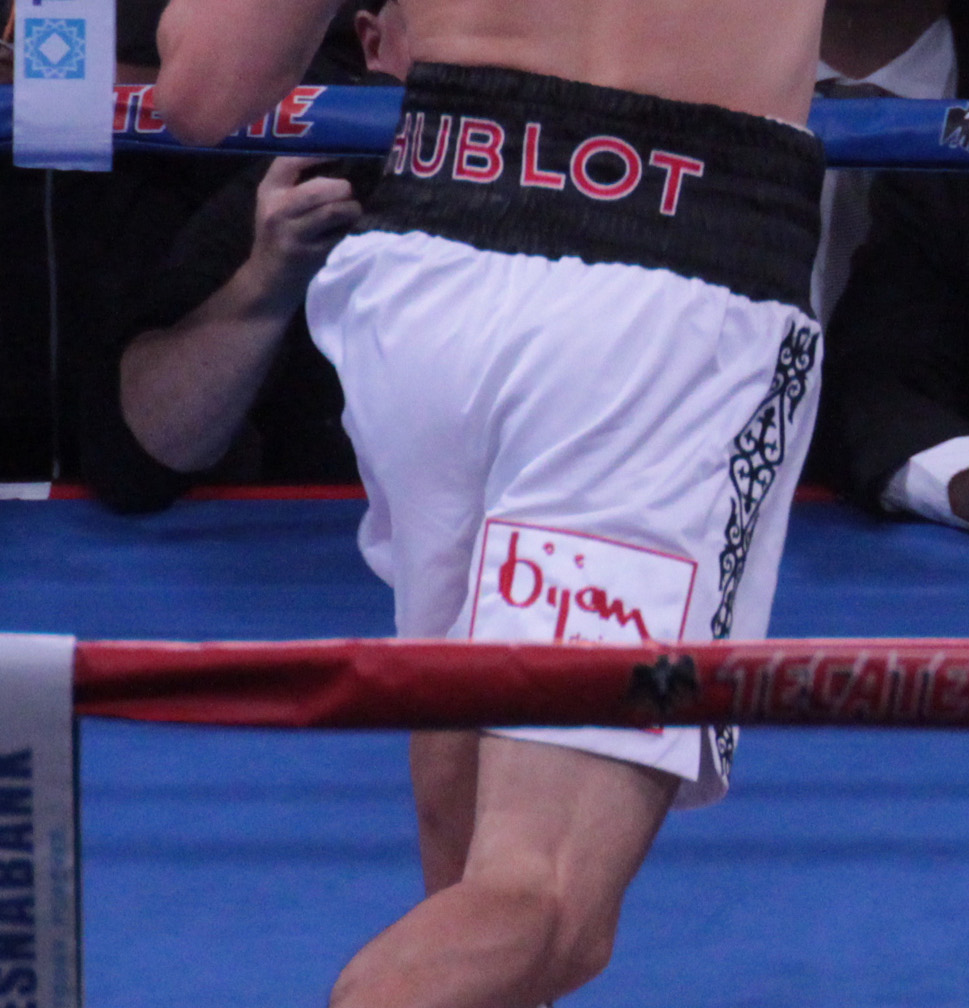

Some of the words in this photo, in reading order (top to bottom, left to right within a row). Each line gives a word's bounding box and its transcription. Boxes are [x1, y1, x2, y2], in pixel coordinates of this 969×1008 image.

[385, 111, 705, 217] HUBLOT
[498, 530, 652, 646] bijan
[0, 747, 38, 1008] SNABANK
